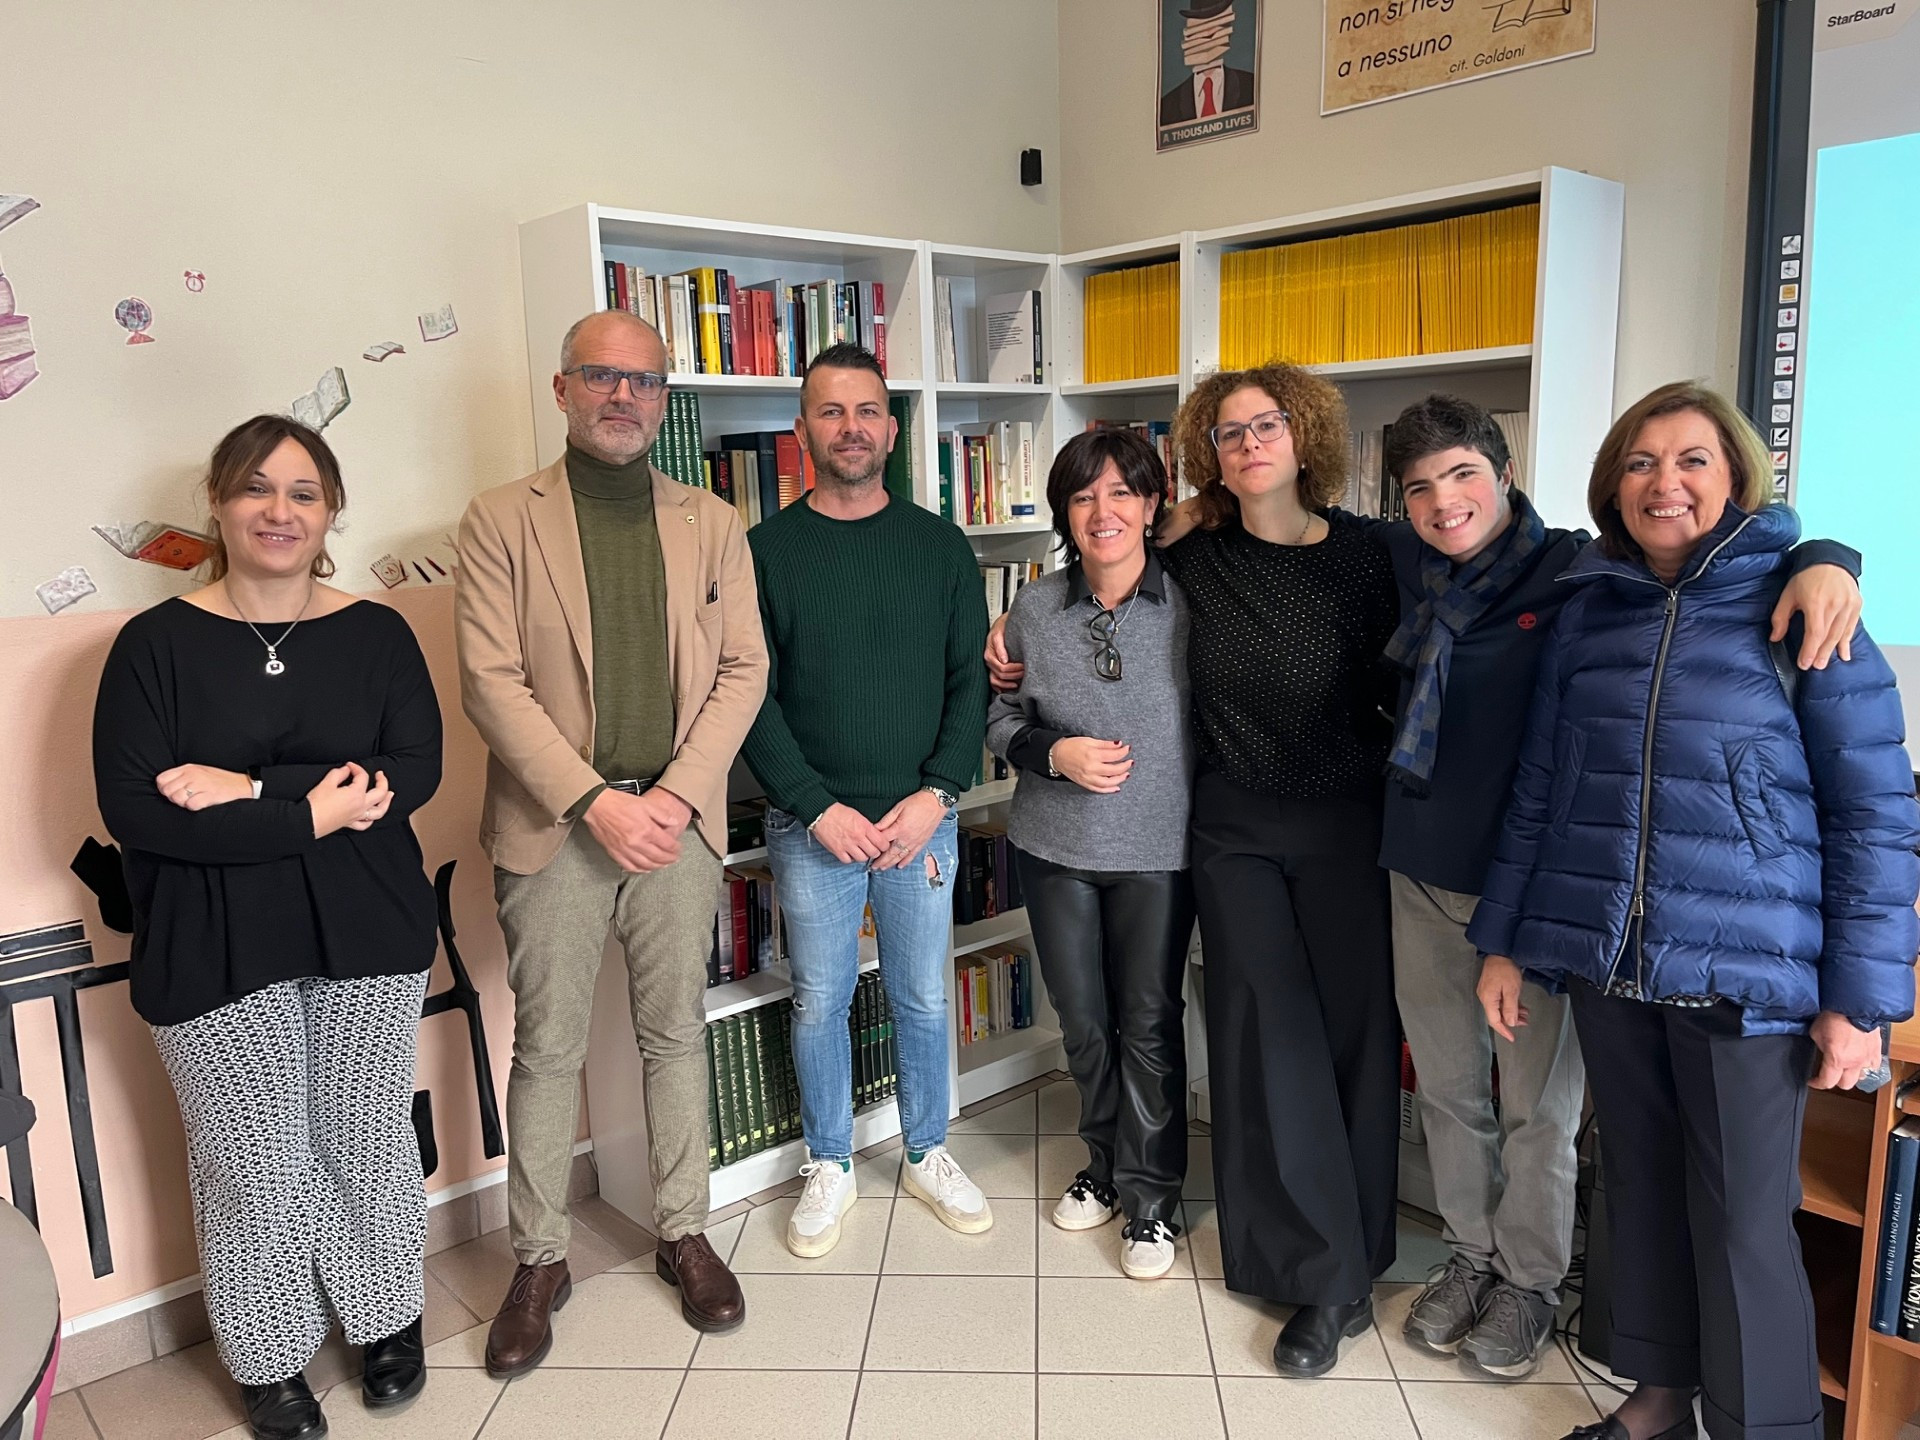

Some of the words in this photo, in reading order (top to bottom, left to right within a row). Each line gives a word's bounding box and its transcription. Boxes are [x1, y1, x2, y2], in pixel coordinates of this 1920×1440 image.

[1339, 8, 1379, 33] non
[1386, 0, 1403, 20] si
[1827, 2, 1896, 28] StarBoard
[1338, 60, 1352, 77] a
[1359, 34, 1453, 73] nessuno
[1449, 59, 1468, 74] cit.
[1473, 44, 1527, 68] Goldoni
[1162, 133, 1170, 144] A
[1171, 121, 1223, 142] THOUSAND
[1225, 114, 1252, 129] LIVES
[1402, 1091, 1413, 1129] FALETTI
[1891, 1192, 1903, 1222] PIACERE
[1888, 1221, 1899, 1245] SANO
[1887, 1245, 1896, 1258] DEL
[1885, 1259, 1895, 1282] L'ARTE
[1907, 1281, 1920, 1305] NOI
